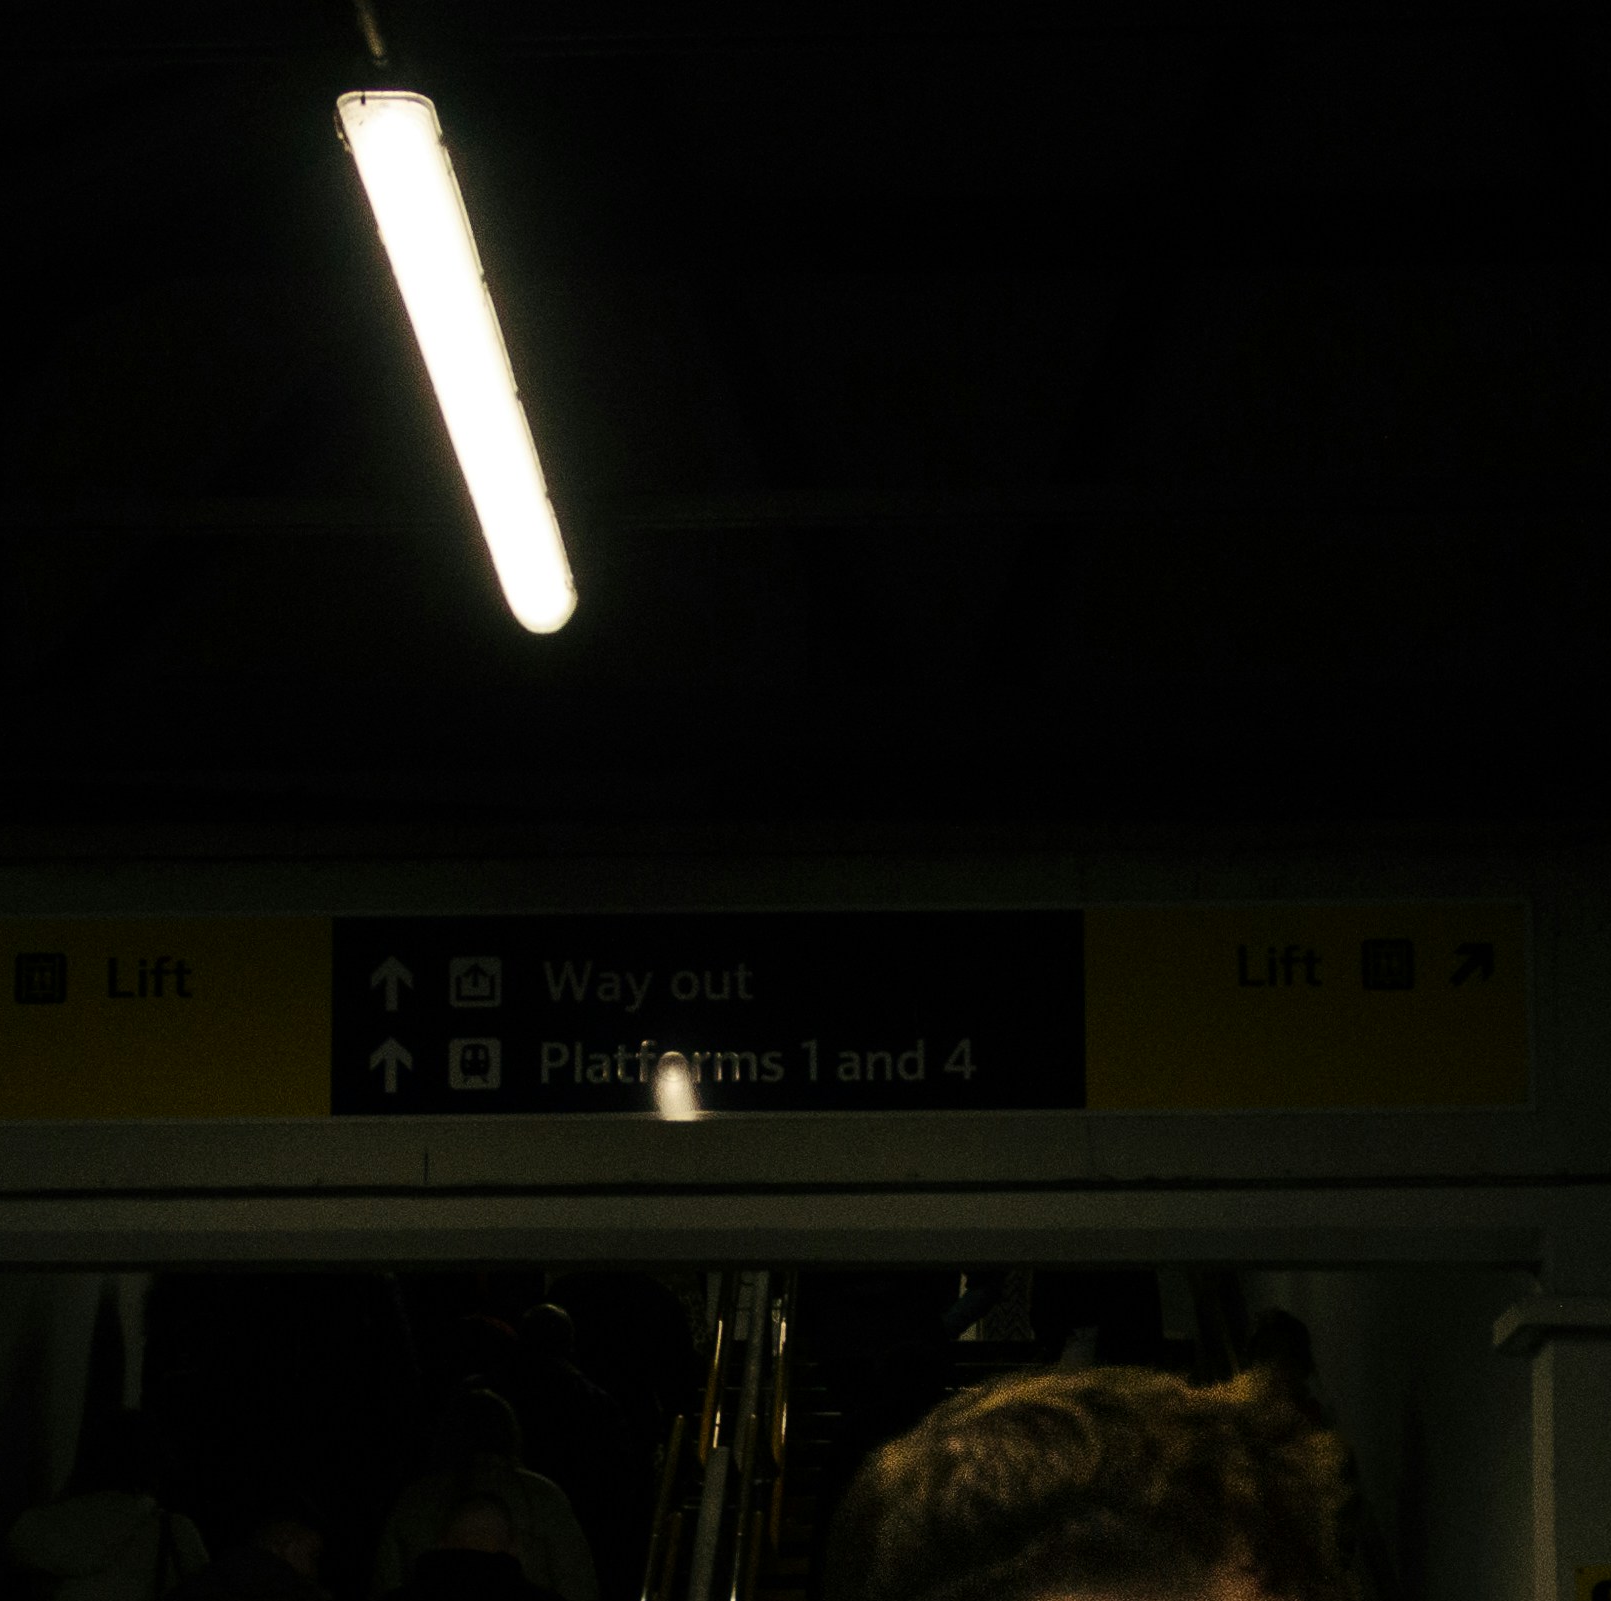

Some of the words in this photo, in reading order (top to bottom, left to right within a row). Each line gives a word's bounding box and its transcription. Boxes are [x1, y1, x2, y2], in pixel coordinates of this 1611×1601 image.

[107, 956, 192, 999] Lift
[541, 959, 653, 1013] Way
[669, 962, 755, 1002] out
[1238, 944, 1322, 987] Lift
[800, 1039, 820, 1083] 1
[835, 1039, 926, 1083] and
[942, 1037, 978, 1082] 4
